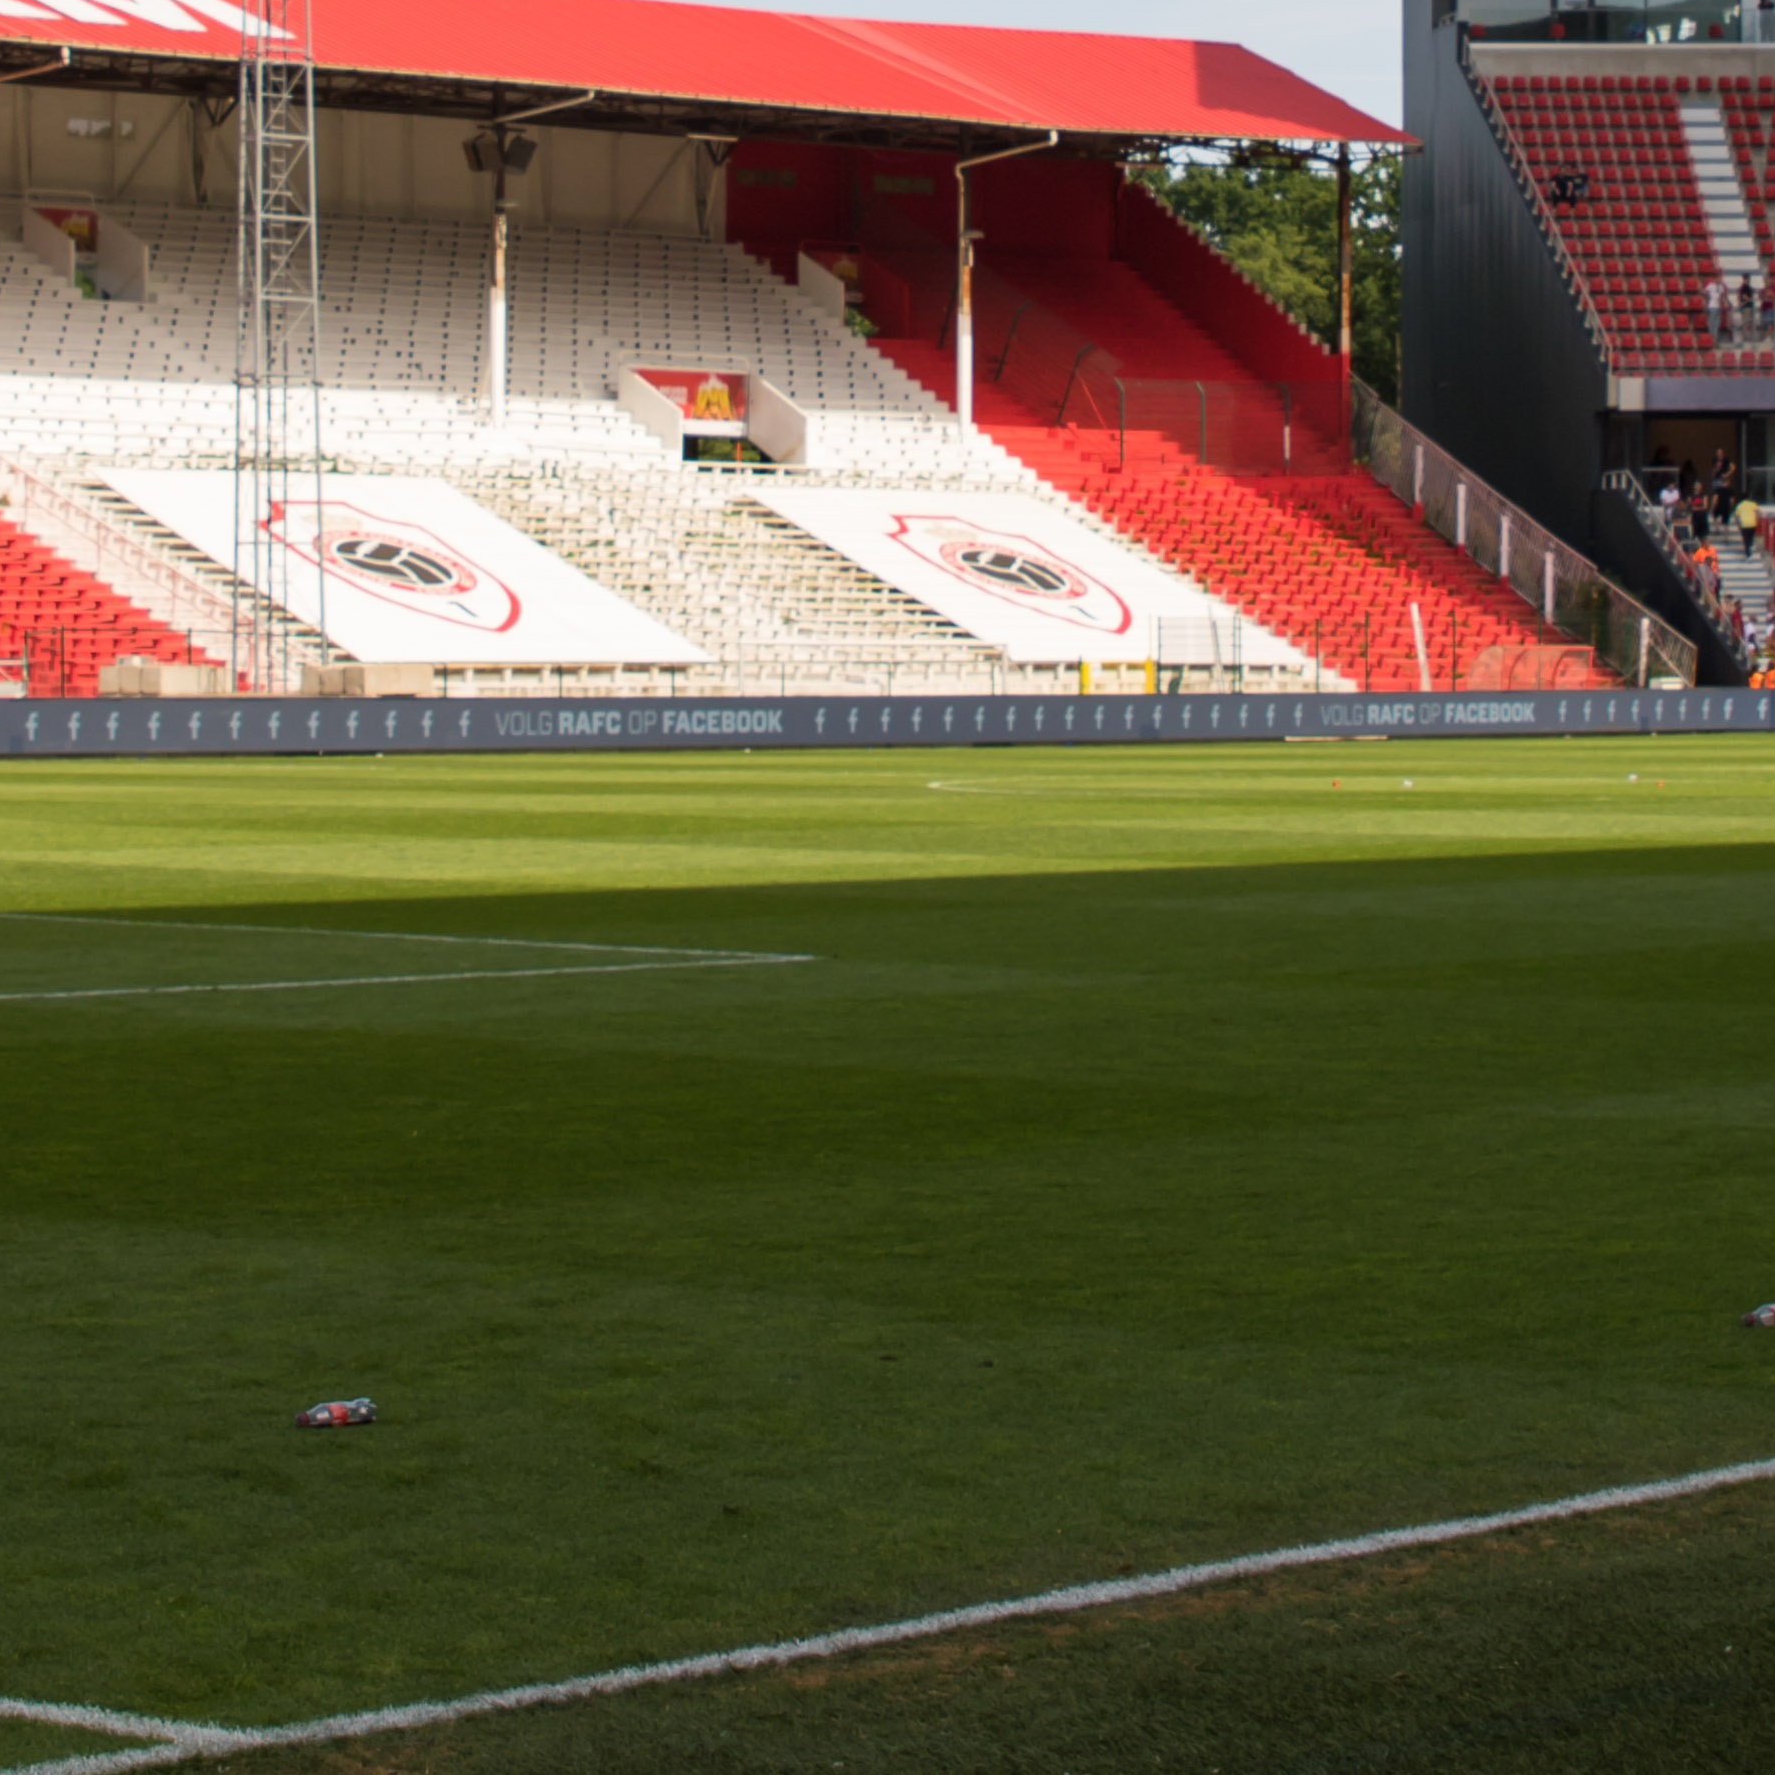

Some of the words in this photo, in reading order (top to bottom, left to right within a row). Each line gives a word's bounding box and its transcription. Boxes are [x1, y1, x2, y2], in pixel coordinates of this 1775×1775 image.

[495, 712, 553, 736] VOLG
[558, 711, 622, 735] RAFC
[628, 710, 658, 734] OP
[662, 709, 783, 734] FACEBOOK
[1321, 704, 1363, 726] VOLG
[1367, 704, 1415, 725] RAFC
[1419, 703, 1442, 724] OP
[1444, 702, 1536, 724] FACEBOOK
